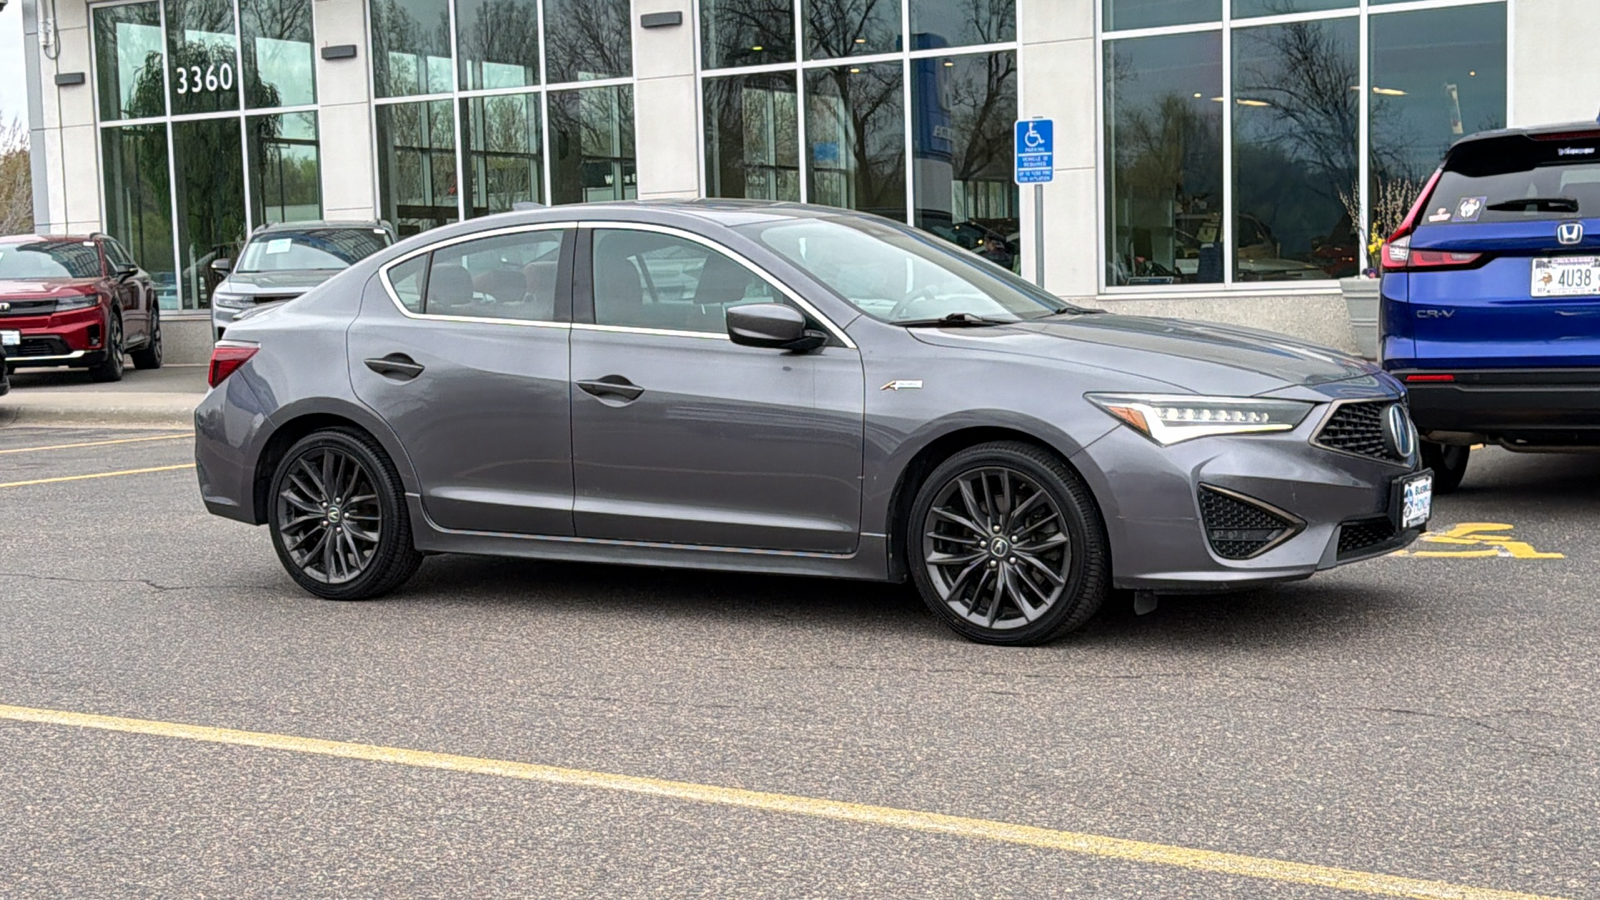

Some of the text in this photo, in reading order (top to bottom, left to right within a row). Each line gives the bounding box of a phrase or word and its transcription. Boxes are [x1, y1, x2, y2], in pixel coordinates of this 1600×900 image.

[176, 62, 233, 94] 3360
[1557, 268, 1592, 287] 4U38
[1416, 309, 1455, 319] CR-V
